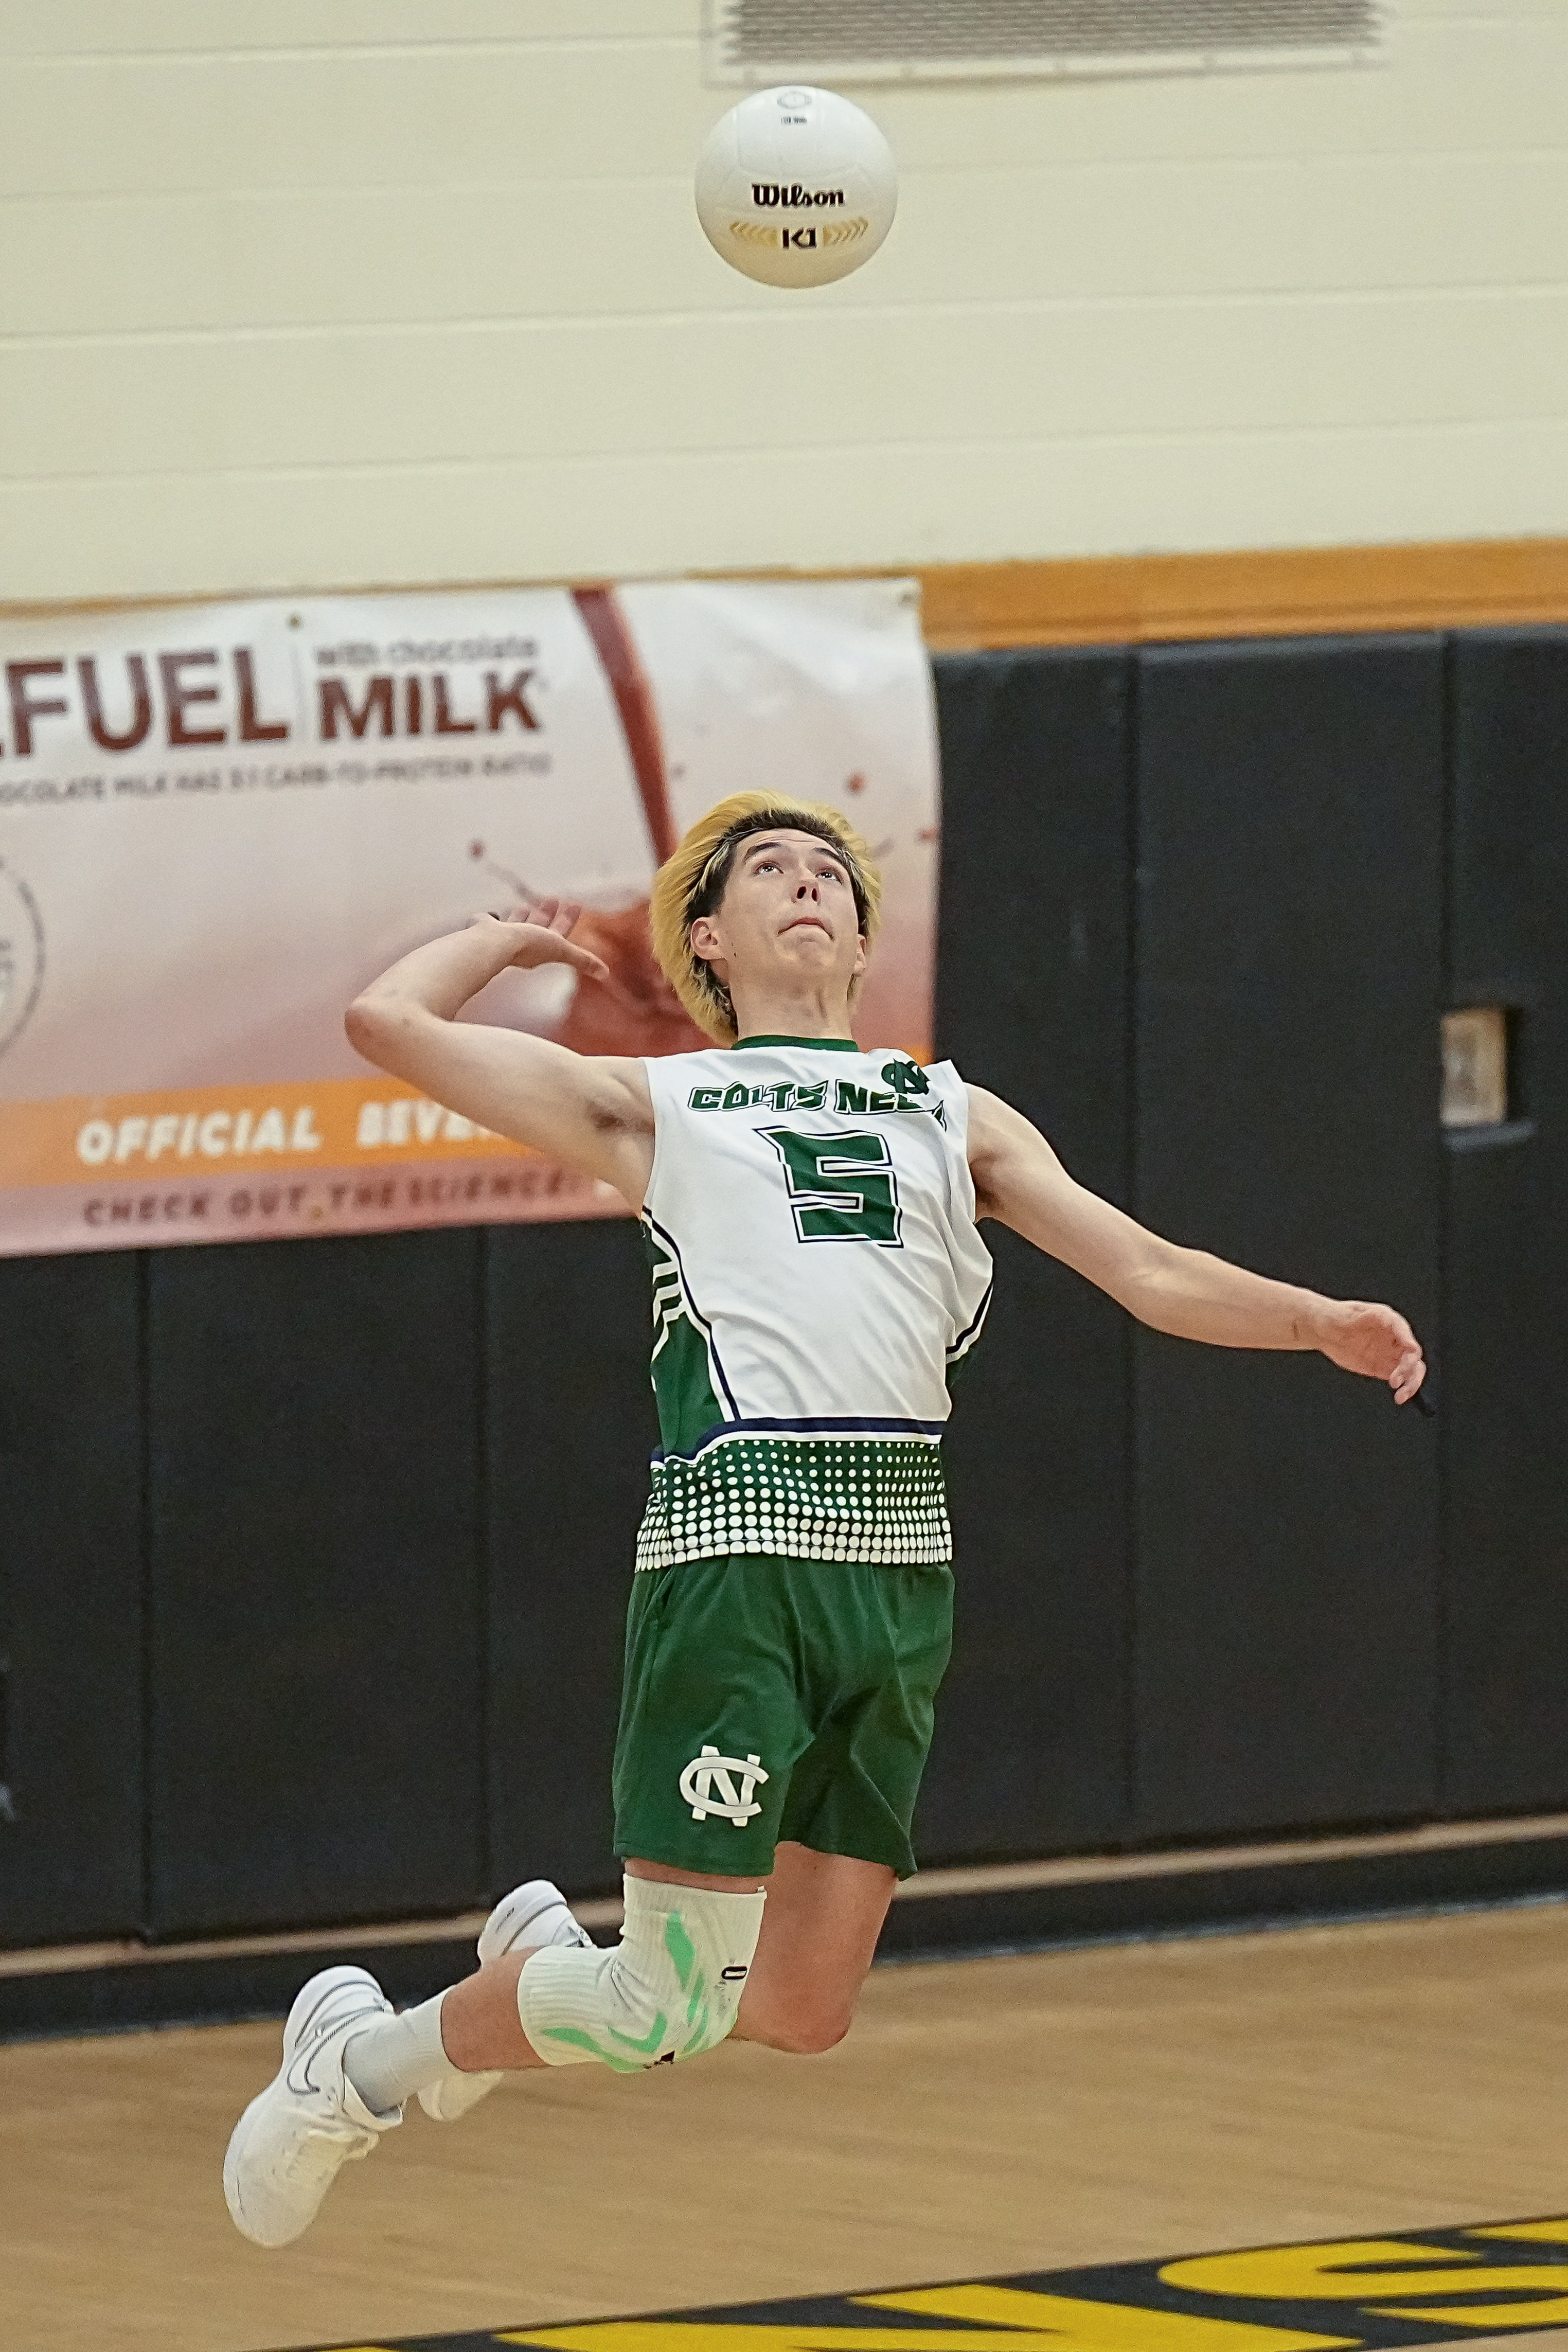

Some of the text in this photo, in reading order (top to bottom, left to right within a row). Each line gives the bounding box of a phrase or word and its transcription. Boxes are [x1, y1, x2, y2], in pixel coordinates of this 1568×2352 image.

[752, 181, 845, 208] Wilson
[782, 227, 817, 250] K1
[387, 636, 538, 664] chocolate
[0, 647, 289, 757] FUEL
[319, 670, 542, 740] MILK
[687, 1080, 829, 1112] COLTS
[78, 1107, 323, 1165] OFFICIAL
[83, 1190, 210, 1227] CHECK
[228, 1184, 308, 1221] OUT
[753, 1126, 904, 1249] 5
